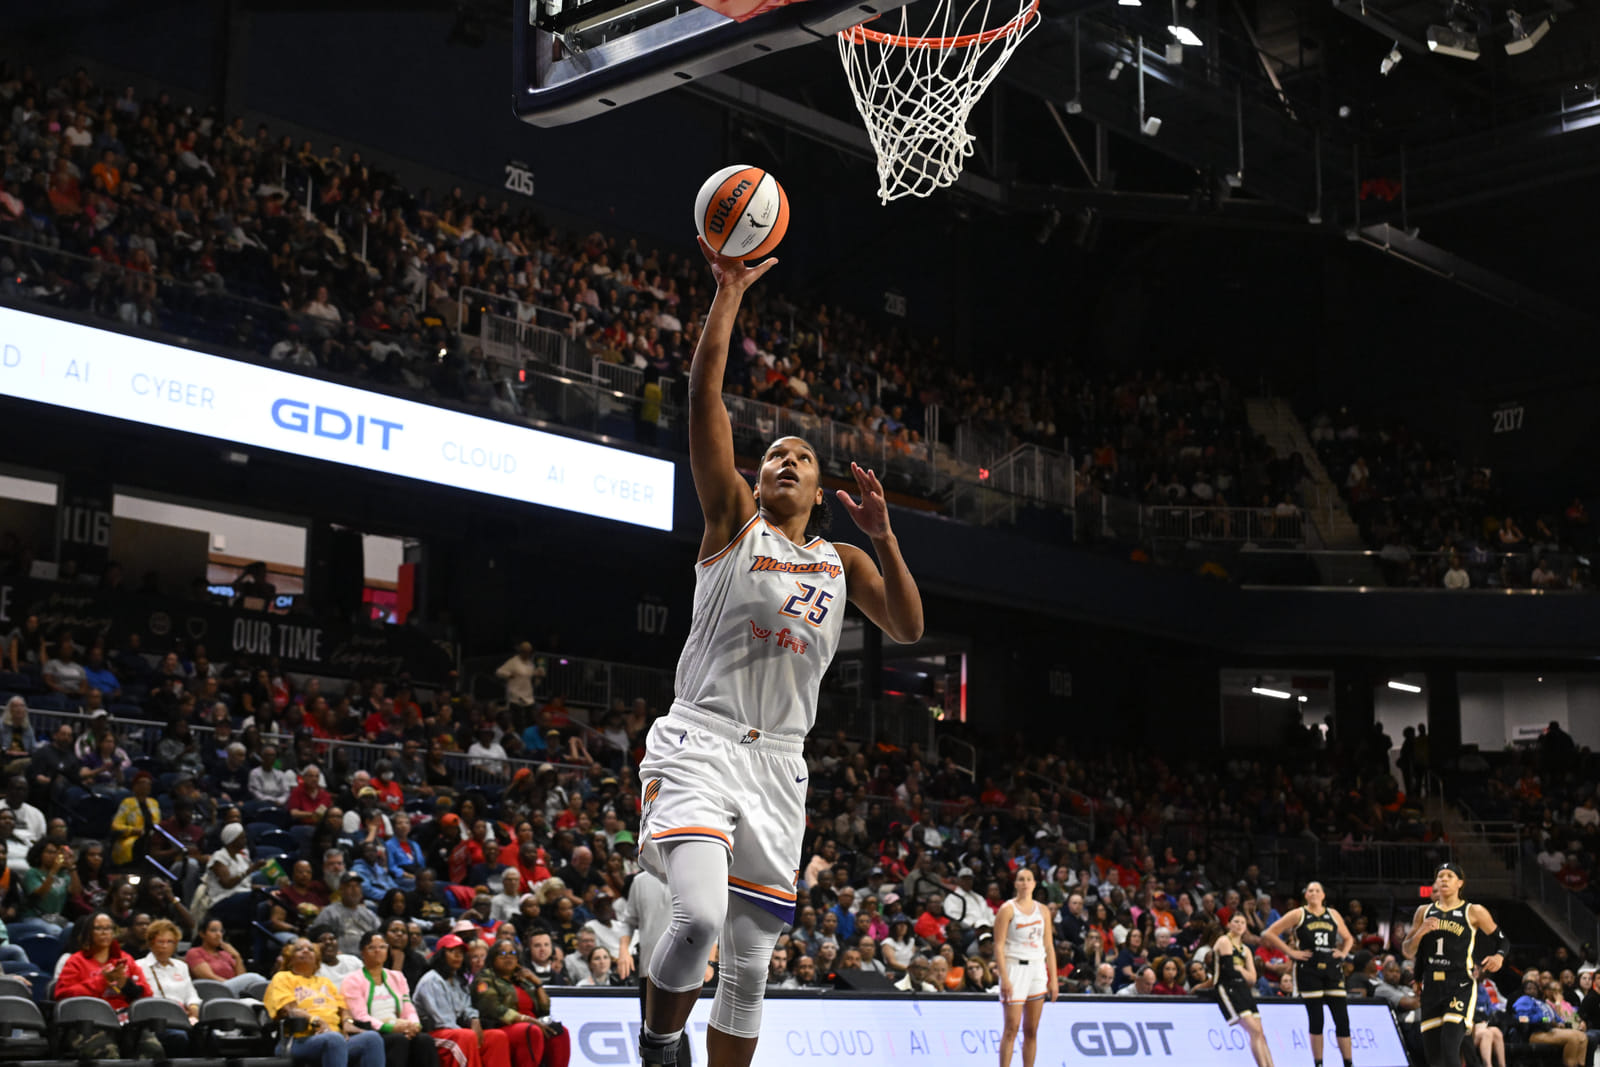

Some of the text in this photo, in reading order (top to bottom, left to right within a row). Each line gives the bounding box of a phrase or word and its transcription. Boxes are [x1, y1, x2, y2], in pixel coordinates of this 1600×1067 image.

[504, 165, 535, 197] 205
[709, 179, 752, 234] Wilson
[64, 358, 90, 384] AI
[130, 372, 215, 410] CYBER
[269, 397, 404, 452] GDIT
[1492, 406, 1524, 433] 207
[441, 440, 655, 504] CLOUD AI CYBER
[63, 505, 110, 547] 106
[749, 555, 842, 579] Mercury
[637, 603, 668, 635] 107
[778, 581, 833, 627] 25
[232, 617, 323, 662] OUR TIME
[1314, 931, 1329, 947] 31
[1434, 937, 1444, 956] 1
[786, 1029, 874, 1057] CLOUD
[910, 1029, 930, 1055] AI
[1071, 1021, 1174, 1056] GDIT
[1207, 1028, 1248, 1051] CLO
[1327, 1027, 1379, 1049] CBER
